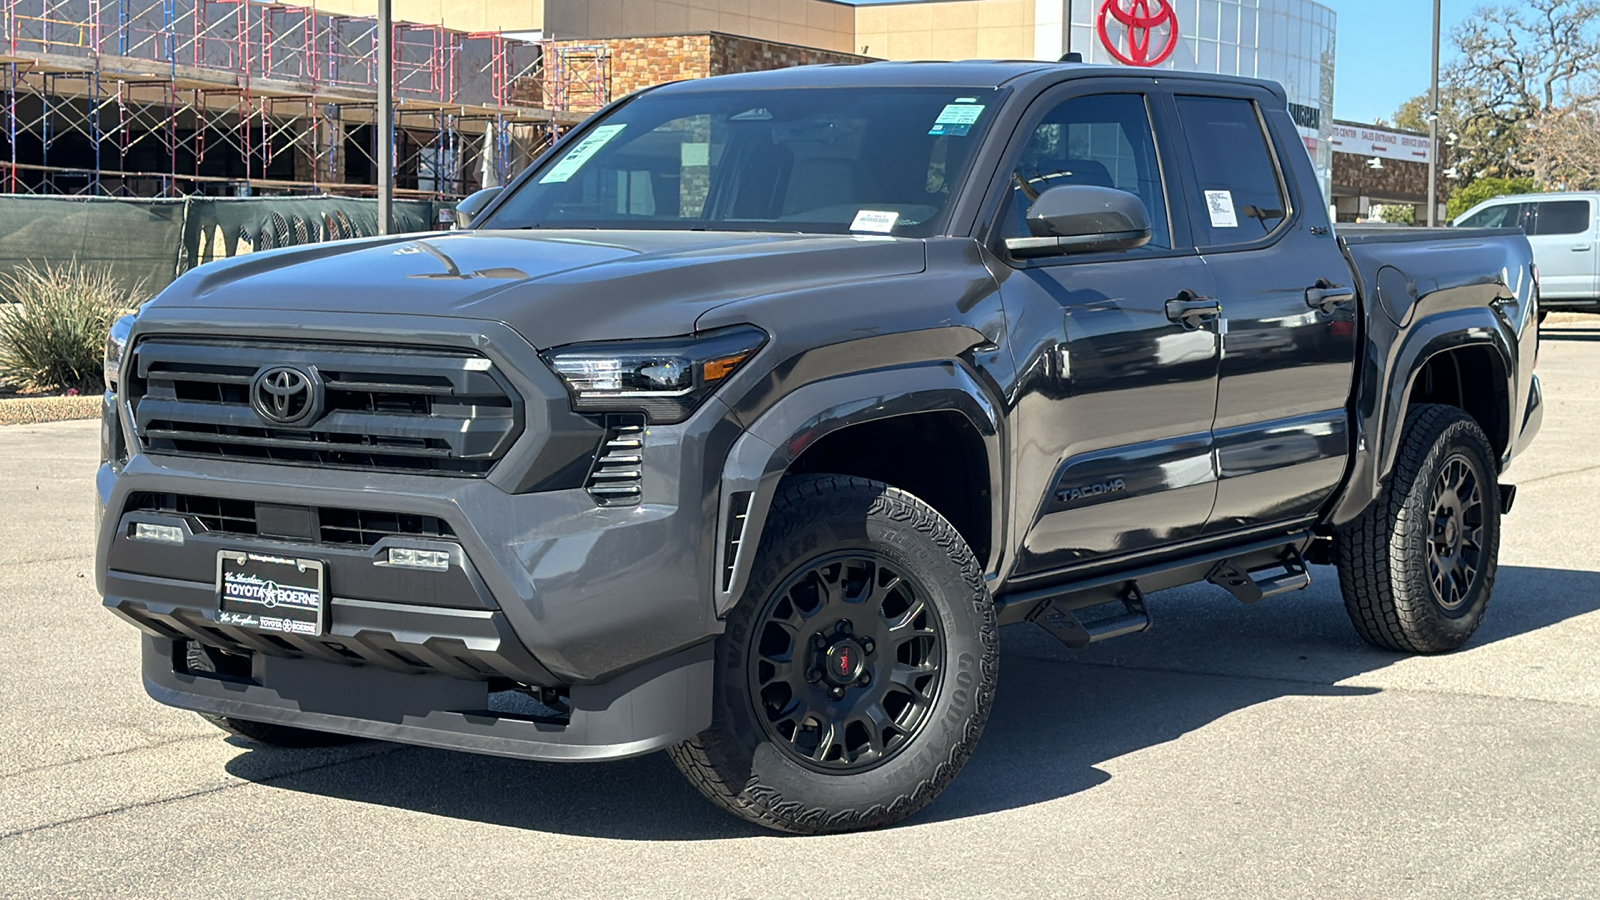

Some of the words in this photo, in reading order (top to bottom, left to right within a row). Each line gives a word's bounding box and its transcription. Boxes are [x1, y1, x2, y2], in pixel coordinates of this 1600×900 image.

[1340, 128, 1357, 139] CENTER
[1361, 131, 1374, 141] SALES
[1375, 132, 1397, 145] ENTRANCE
[1401, 137, 1417, 148] SERVICE
[1057, 478, 1126, 502] TACOMA
[225, 582, 265, 598] TOYOTA
[278, 589, 319, 606] BOERNE
[260, 618, 282, 628] TOYOTA
